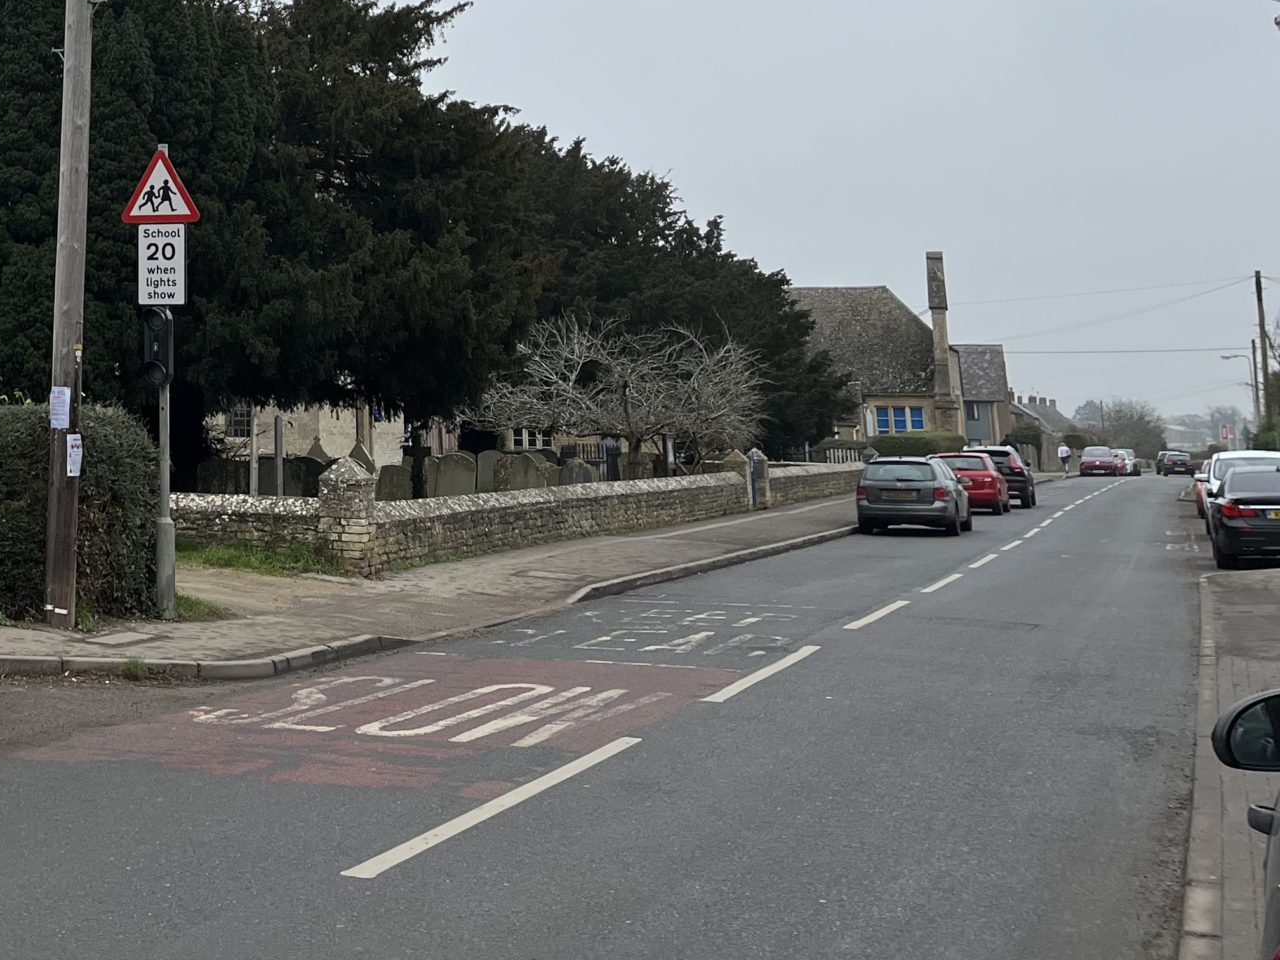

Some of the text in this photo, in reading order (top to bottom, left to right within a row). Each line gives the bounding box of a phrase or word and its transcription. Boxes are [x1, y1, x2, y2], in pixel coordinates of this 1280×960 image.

[143, 228, 181, 238] School
[146, 242, 176, 261] 20
[147, 265, 176, 275] when
[146, 277, 177, 289] lights
[147, 289, 176, 300] show
[189, 675, 674, 748] SLOW
